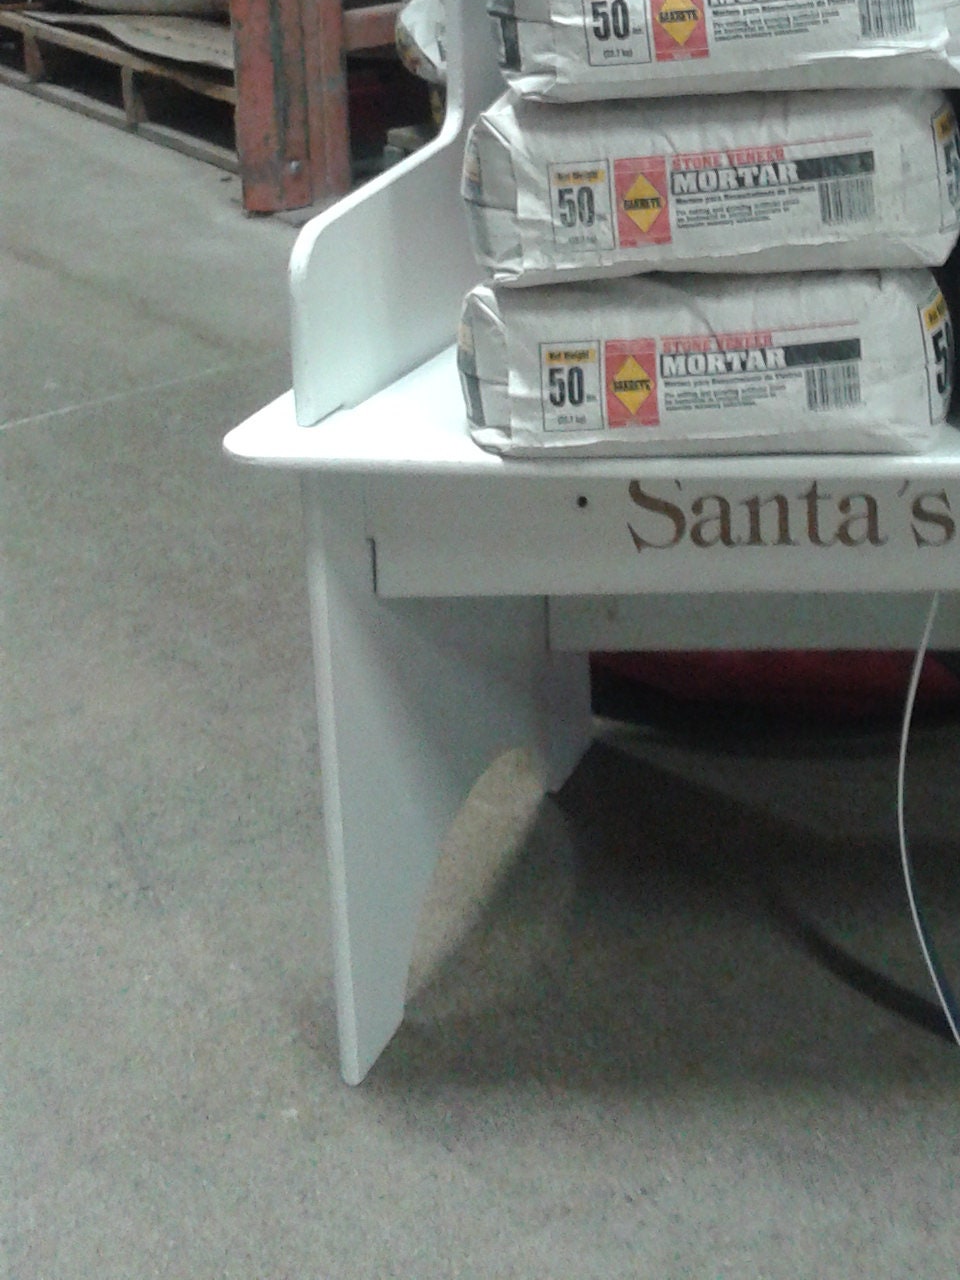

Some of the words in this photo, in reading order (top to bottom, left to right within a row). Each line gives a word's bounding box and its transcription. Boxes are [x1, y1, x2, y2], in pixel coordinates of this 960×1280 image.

[672, 160, 799, 195] MORTAR
[557, 185, 596, 228] 50
[661, 345, 787, 378] MORTAR
[549, 365, 585, 408] 50
[627, 477, 958, 554] Santa's
